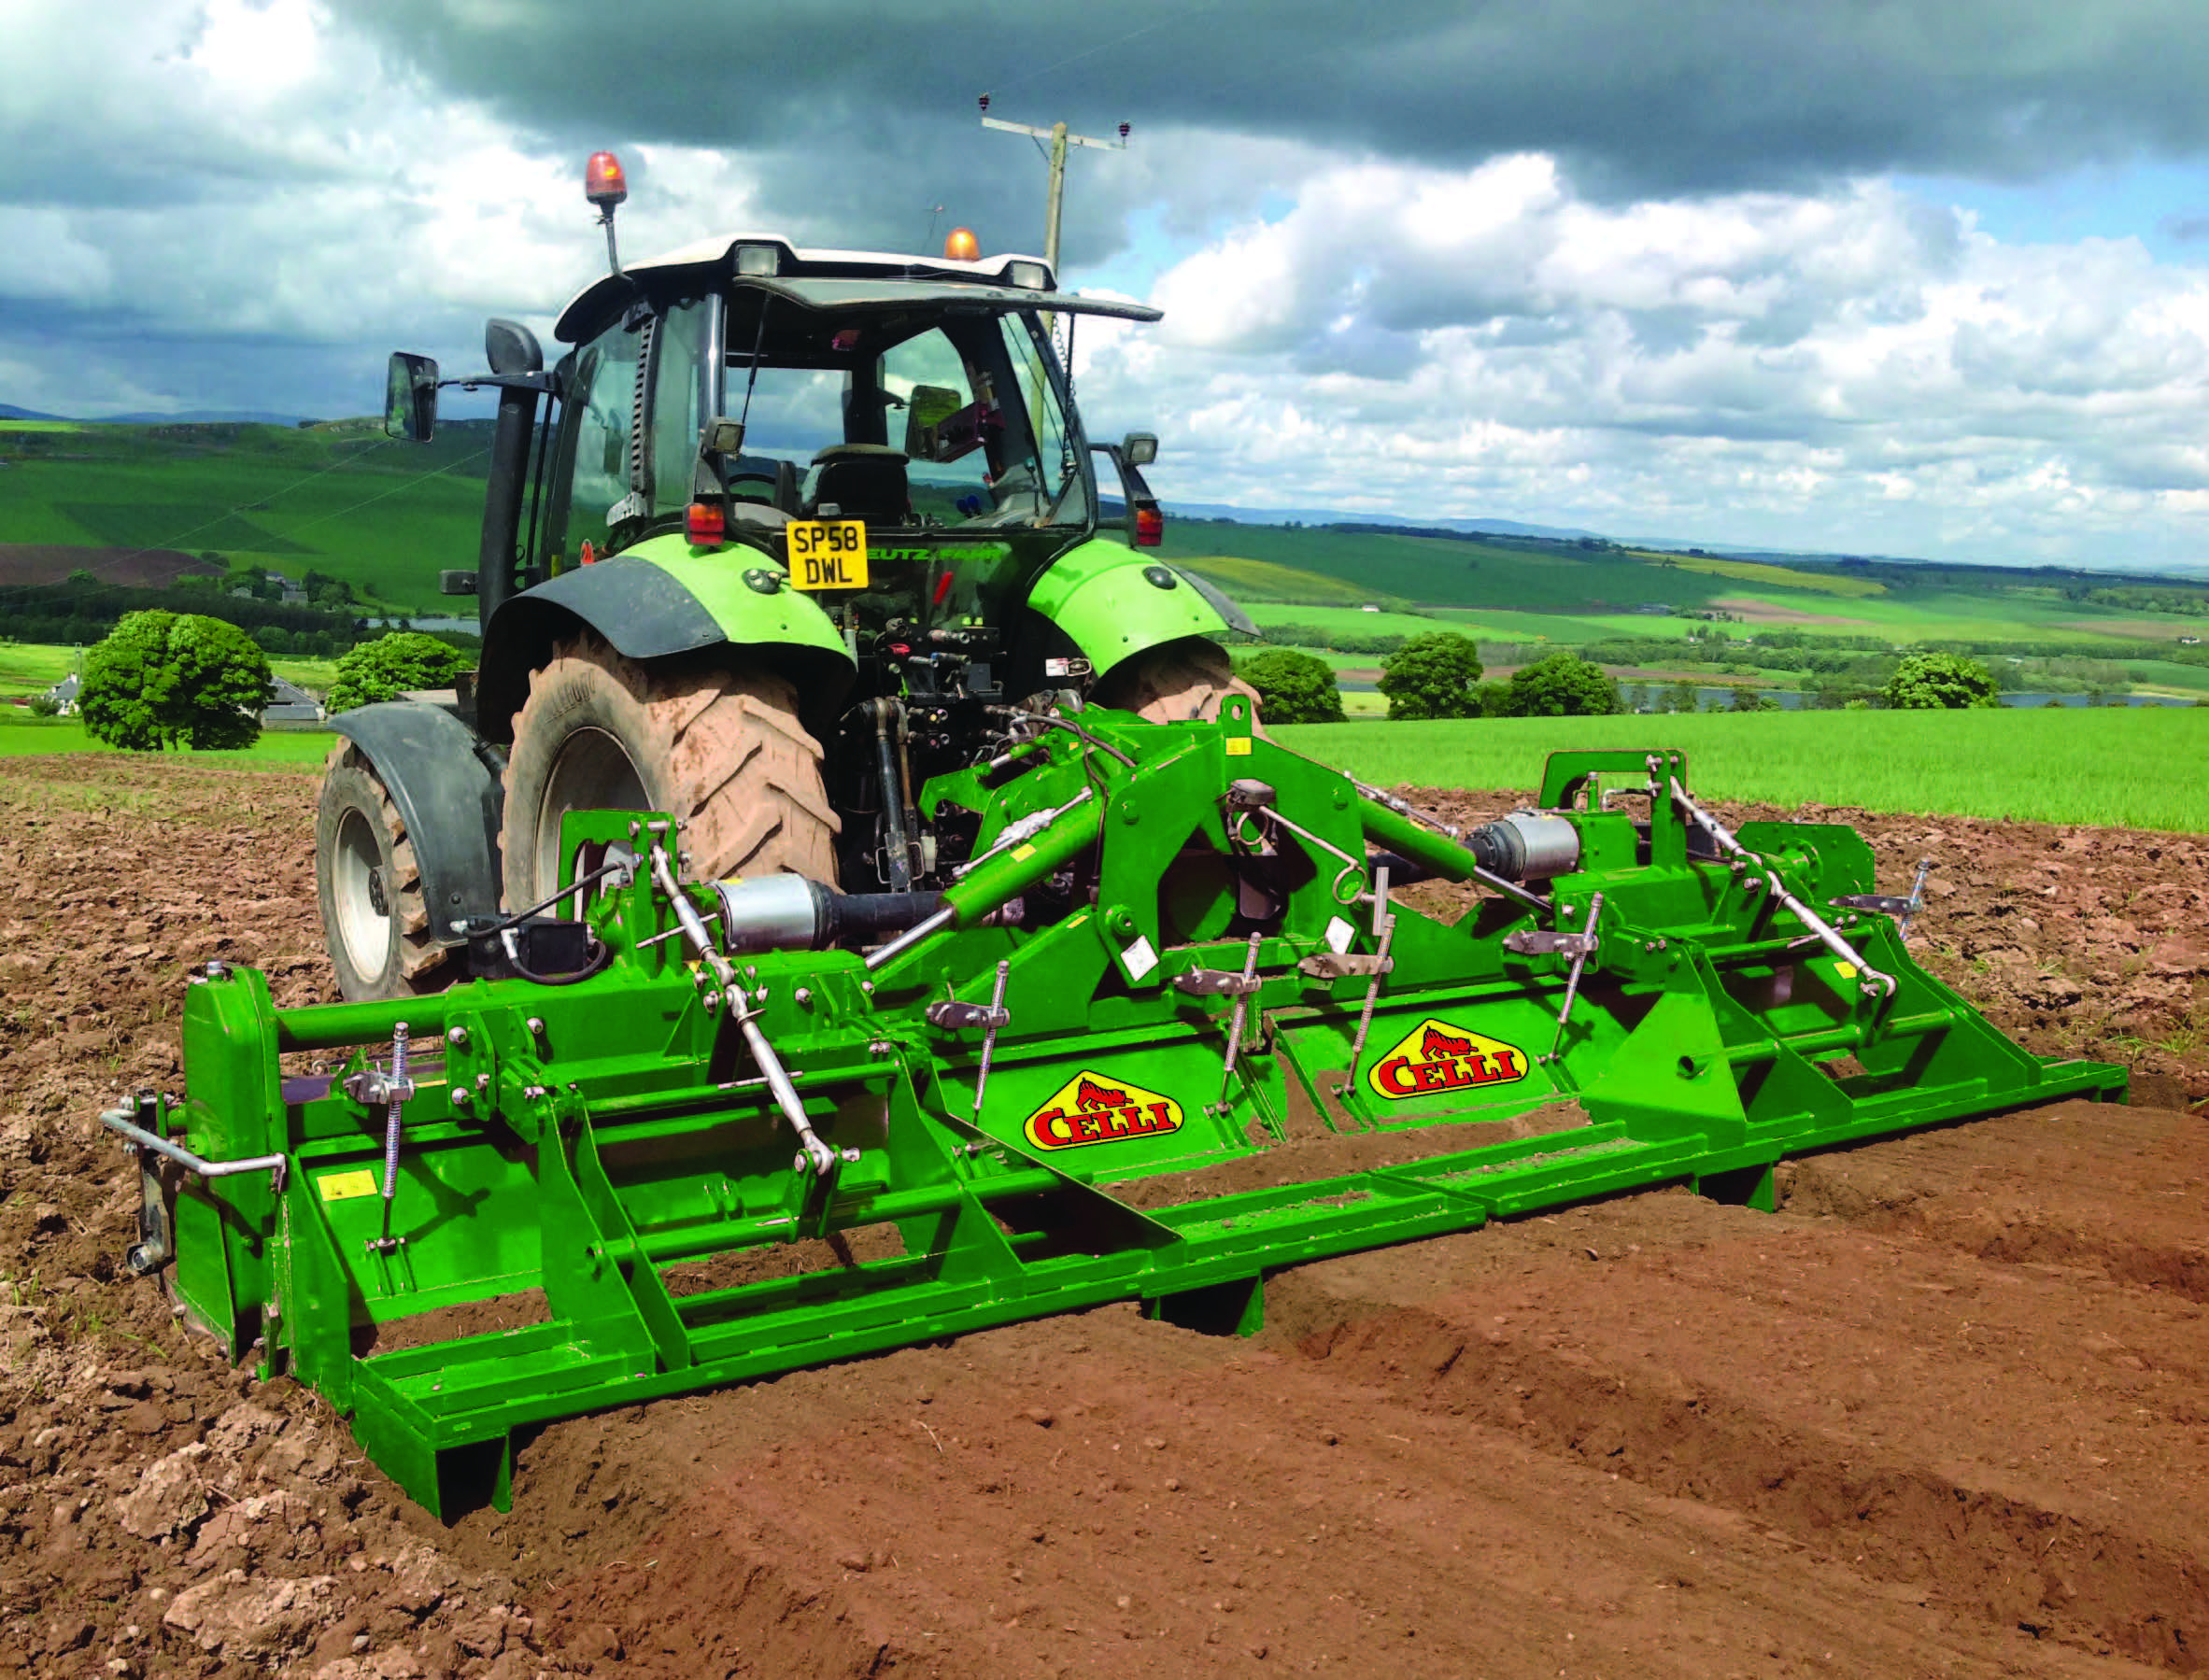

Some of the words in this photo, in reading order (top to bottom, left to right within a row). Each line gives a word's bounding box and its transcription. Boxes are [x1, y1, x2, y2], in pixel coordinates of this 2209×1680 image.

[794, 526, 858, 554] SP58
[867, 547, 929, 560] EUTZ
[805, 558, 853, 585] DWL
[1378, 1051, 1522, 1095] CELLI
[1033, 1102, 1177, 1147] CELLI
